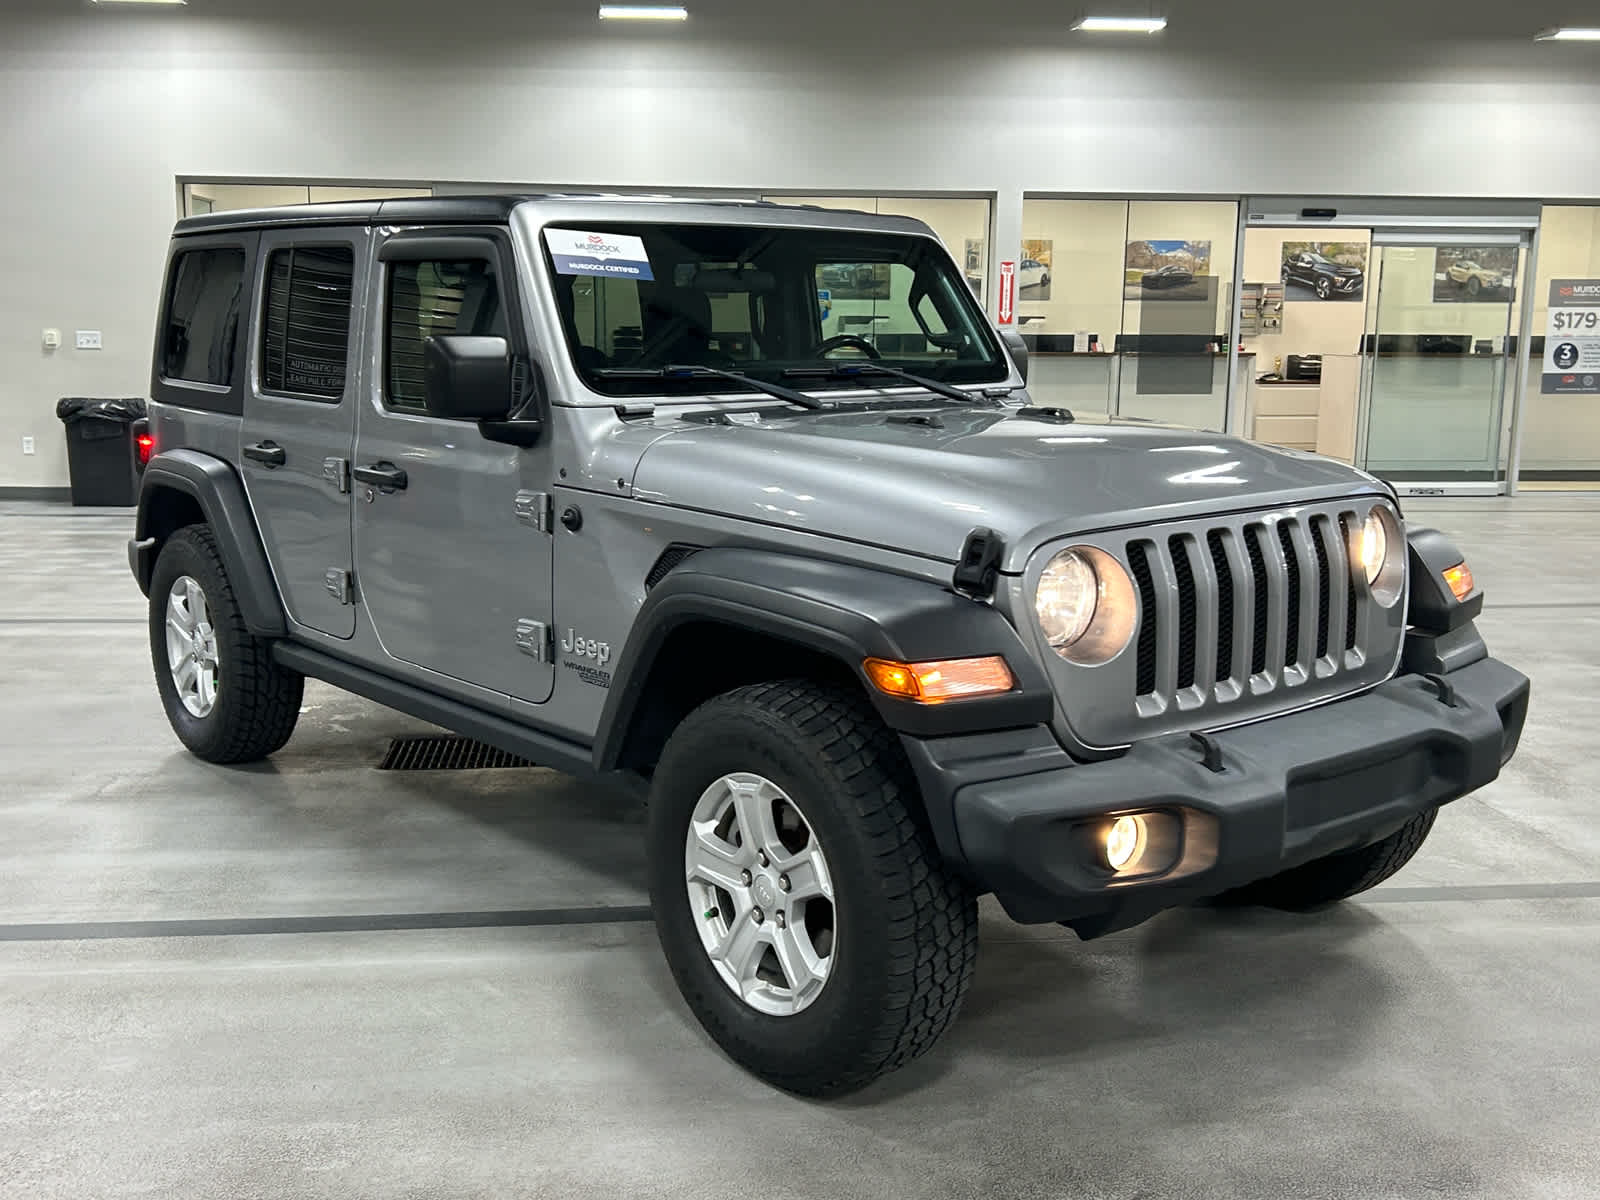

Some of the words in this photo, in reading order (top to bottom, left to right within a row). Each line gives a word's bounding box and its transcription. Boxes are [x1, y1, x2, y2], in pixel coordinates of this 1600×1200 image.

[574, 241, 621, 254] MURDOCK
[568, 262, 604, 272] MURDOCK
[606, 265, 639, 275] CERTIFIED
[1553, 311, 1597, 330] $179
[1560, 345, 1572, 360] 3
[561, 628, 610, 666] Jeep
[563, 660, 610, 679] WRANGLER
